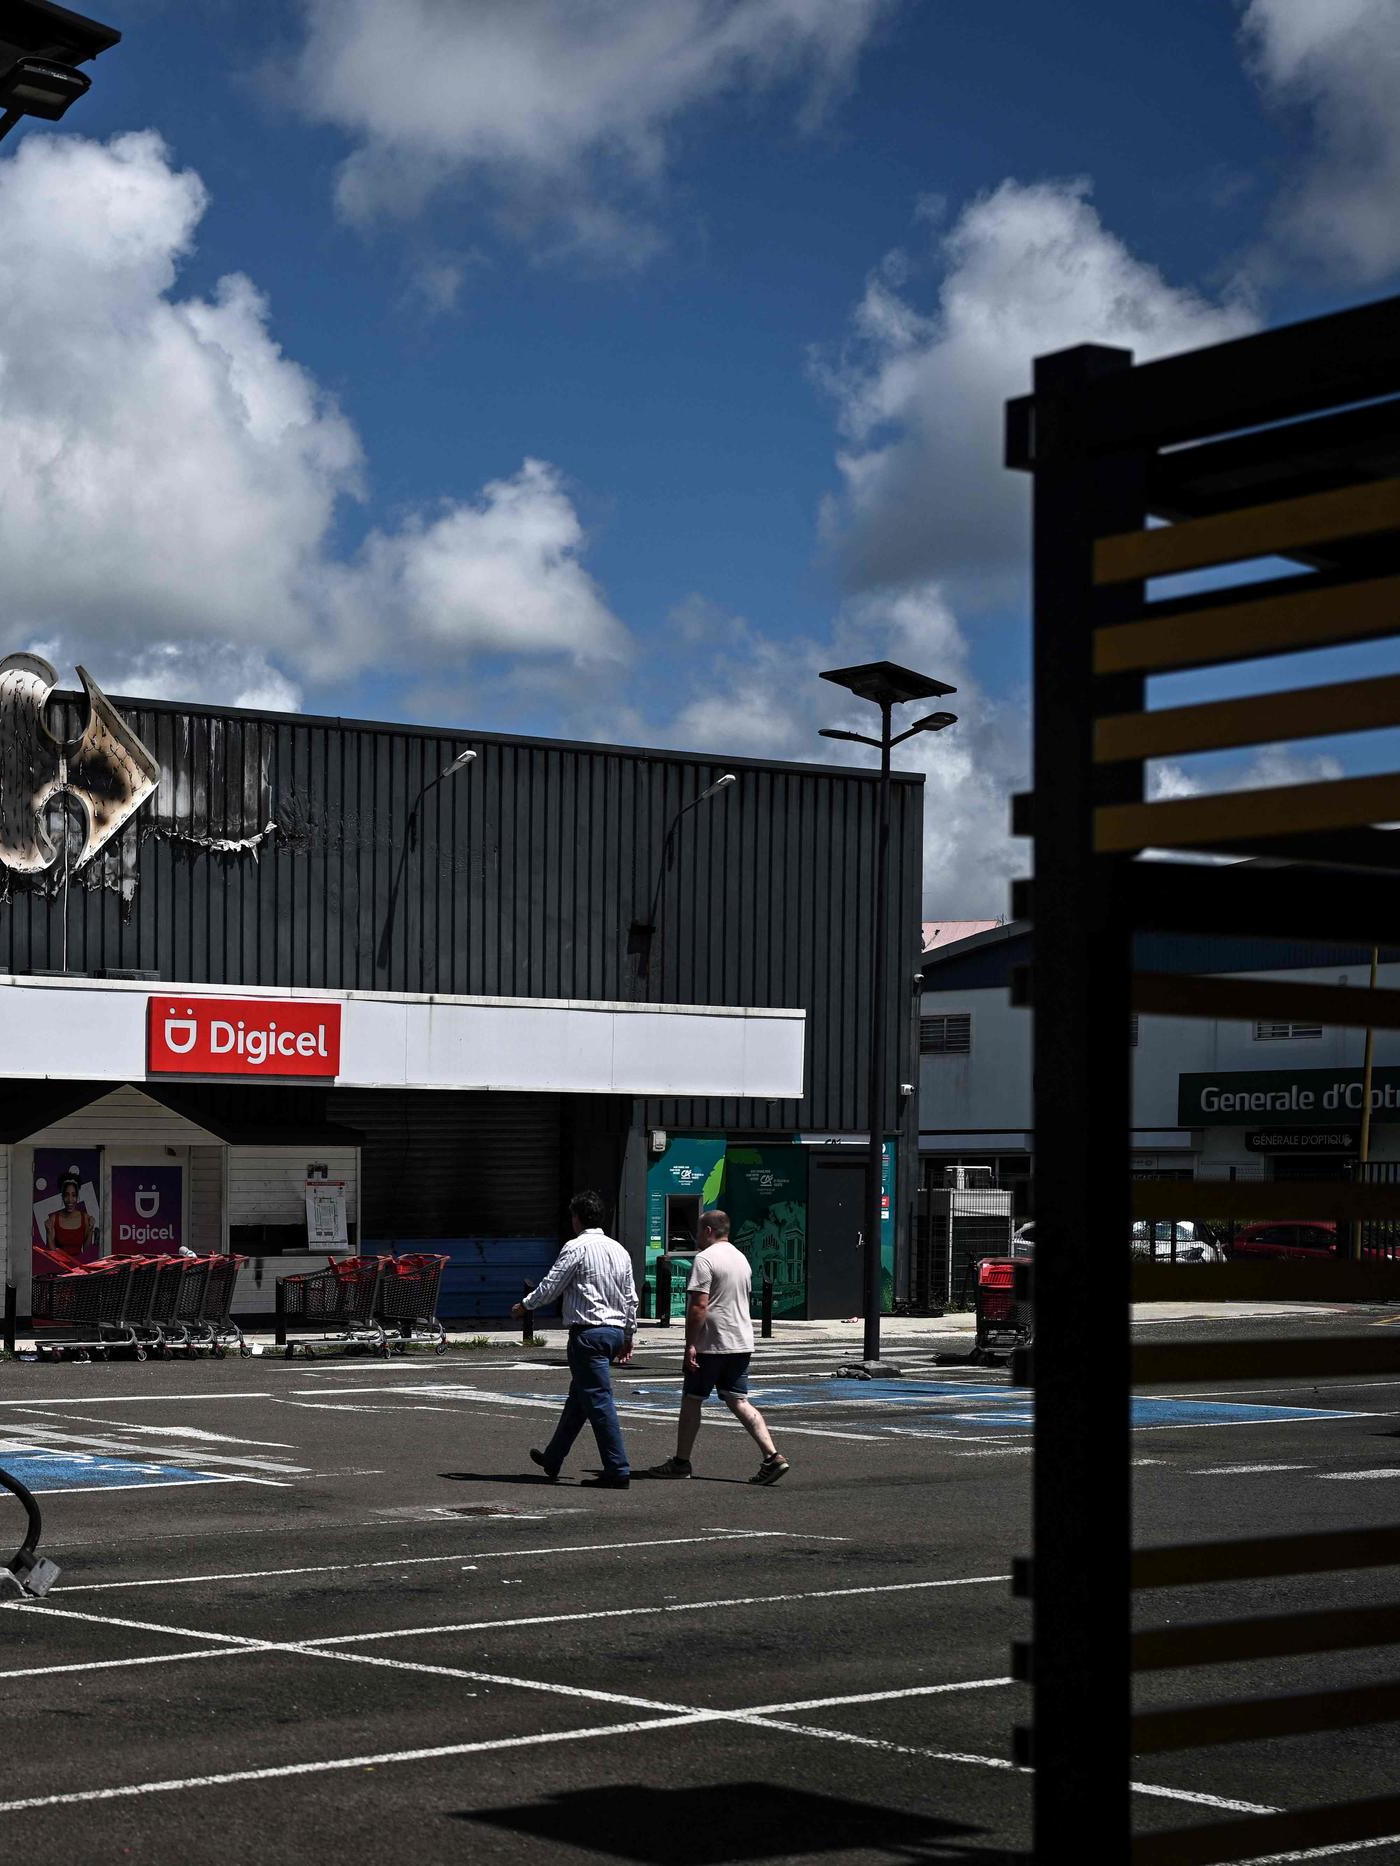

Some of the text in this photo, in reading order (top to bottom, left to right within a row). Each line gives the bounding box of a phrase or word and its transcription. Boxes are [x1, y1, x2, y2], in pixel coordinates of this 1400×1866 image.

[210, 1021, 329, 1065] Digicel
[1200, 1084, 1315, 1112] Generale
[119, 1223, 175, 1245] Digicel
